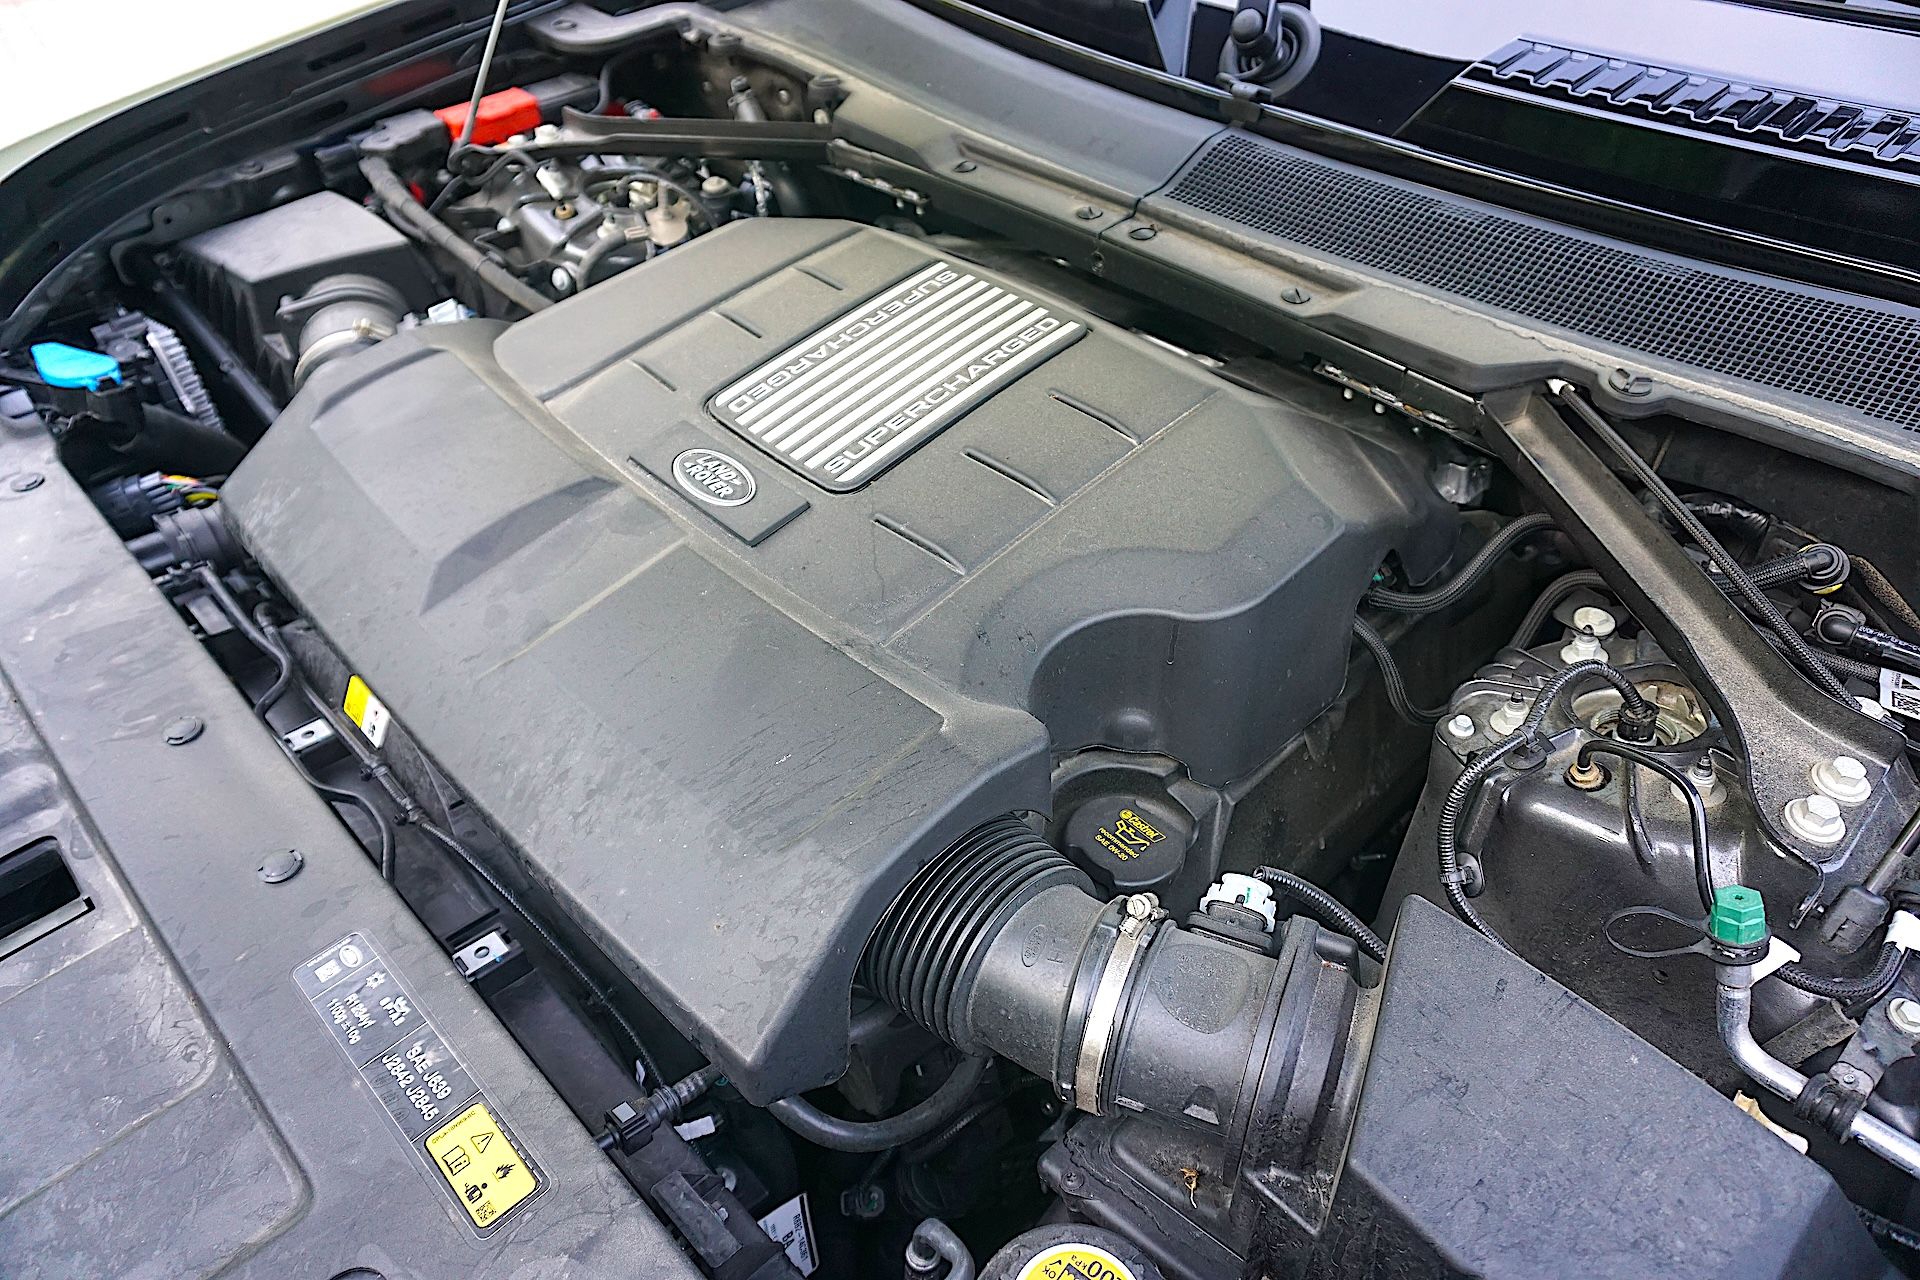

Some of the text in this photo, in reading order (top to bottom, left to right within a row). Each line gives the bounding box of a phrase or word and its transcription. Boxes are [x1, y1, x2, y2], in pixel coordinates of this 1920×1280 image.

[728, 269, 959, 413] SUPERCHARGED
[823, 317, 1060, 473] SUPERCHARGED
[685, 463, 734, 498] ROVER
[695, 455, 737, 481] LAND
[1094, 834, 1109, 847] SAE
[1098, 827, 1140, 859] recommended
[1128, 816, 1160, 839] Castrol
[381, 1053, 440, 1122] J2842 J2845
[405, 1044, 452, 1101] SAE J639
[1042, 1265, 1057, 1279] OK
[1087, 1260, 1122, 1280] 00
